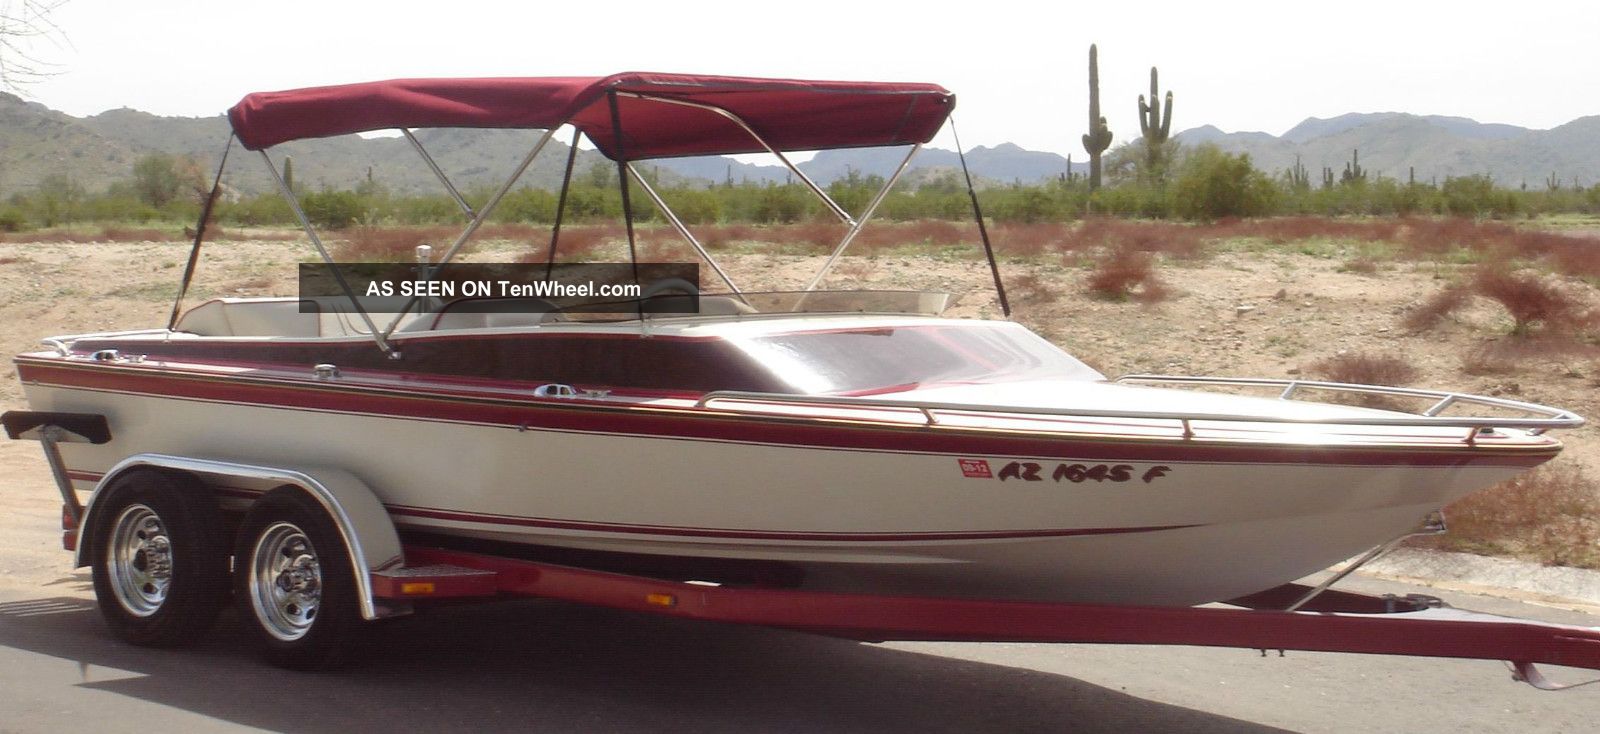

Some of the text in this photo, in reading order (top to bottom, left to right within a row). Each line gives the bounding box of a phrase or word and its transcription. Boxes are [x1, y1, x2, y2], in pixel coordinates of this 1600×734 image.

[998, 461, 1173, 483] AZ 1645 F
